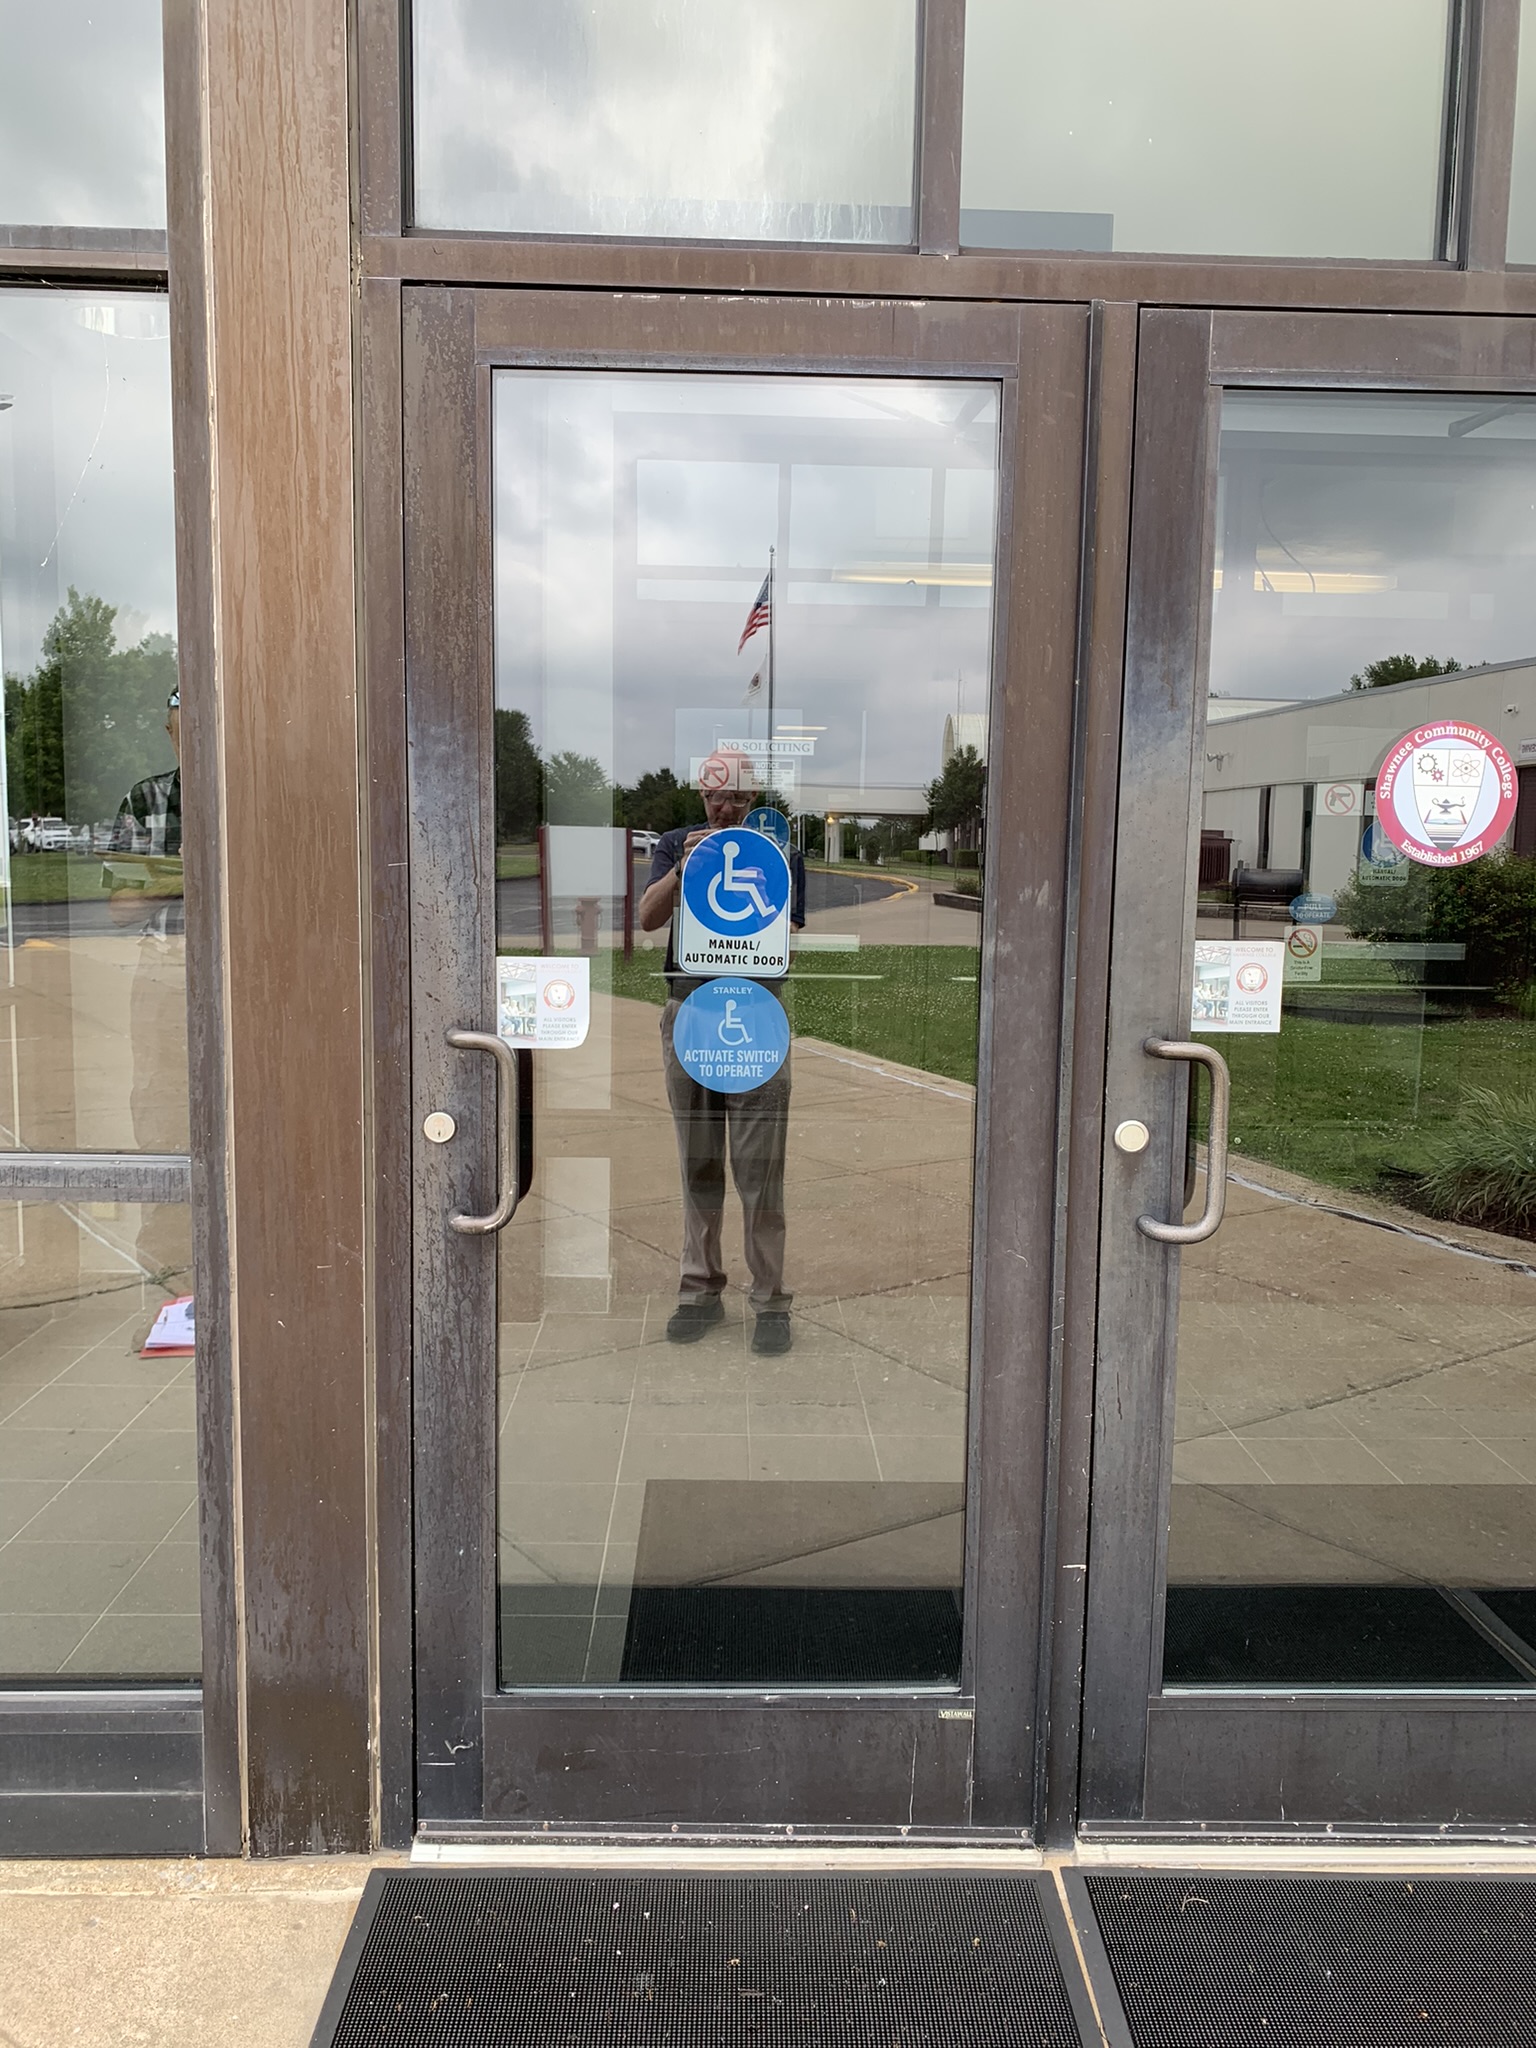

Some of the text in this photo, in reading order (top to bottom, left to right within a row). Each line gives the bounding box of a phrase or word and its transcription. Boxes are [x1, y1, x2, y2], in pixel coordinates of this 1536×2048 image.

[721, 741, 811, 753] NO SOLICITING
[756, 761, 780, 769] NOTICE
[1380, 725, 1513, 799] Shawnee Community College
[1400, 839, 1484, 864] Established 1967
[1304, 903, 1322, 911] PULL
[709, 939, 761, 952] MANUAL/
[684, 952, 784, 967] AUTOMATIC DOOR
[712, 986, 753, 995] STANLEY
[684, 1049, 779, 1063] ACTIVATE SWITCH
[699, 1064, 764, 1078] TO OPERATE
